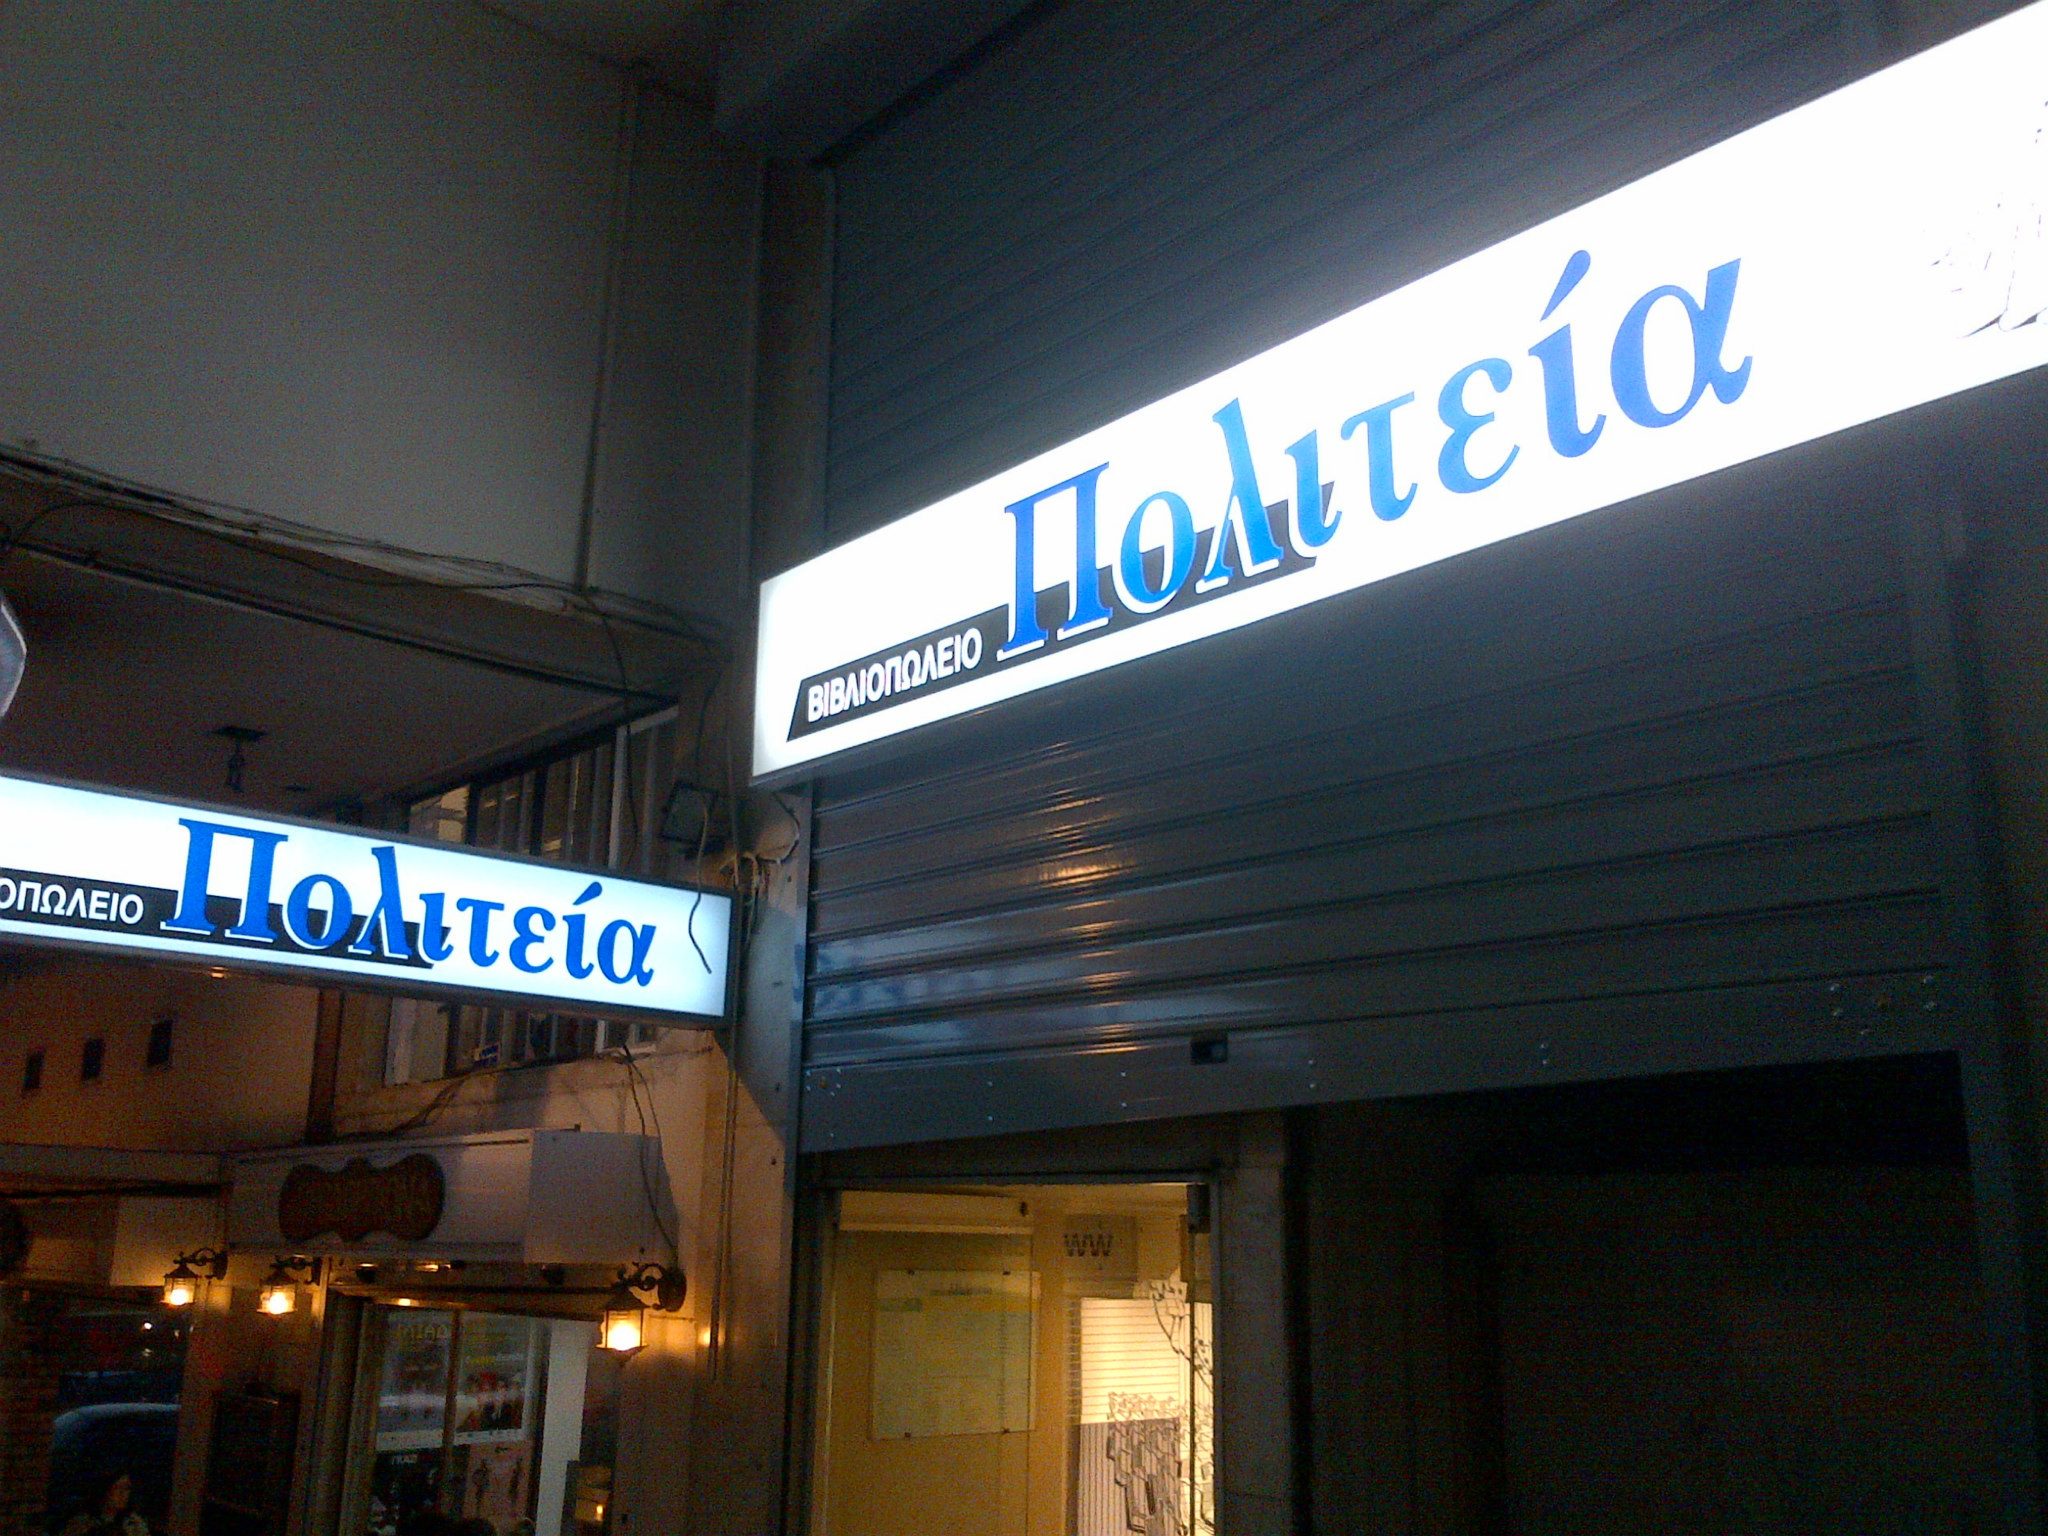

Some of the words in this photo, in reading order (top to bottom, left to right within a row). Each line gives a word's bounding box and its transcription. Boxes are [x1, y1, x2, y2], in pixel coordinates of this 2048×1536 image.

[807, 627, 983, 723] ΒΙΒΛΙΟΠΩΛΕΙΟ
[998, 250, 1753, 659] Πολιτεία
[161, 817, 657, 987] Πολιτεία
